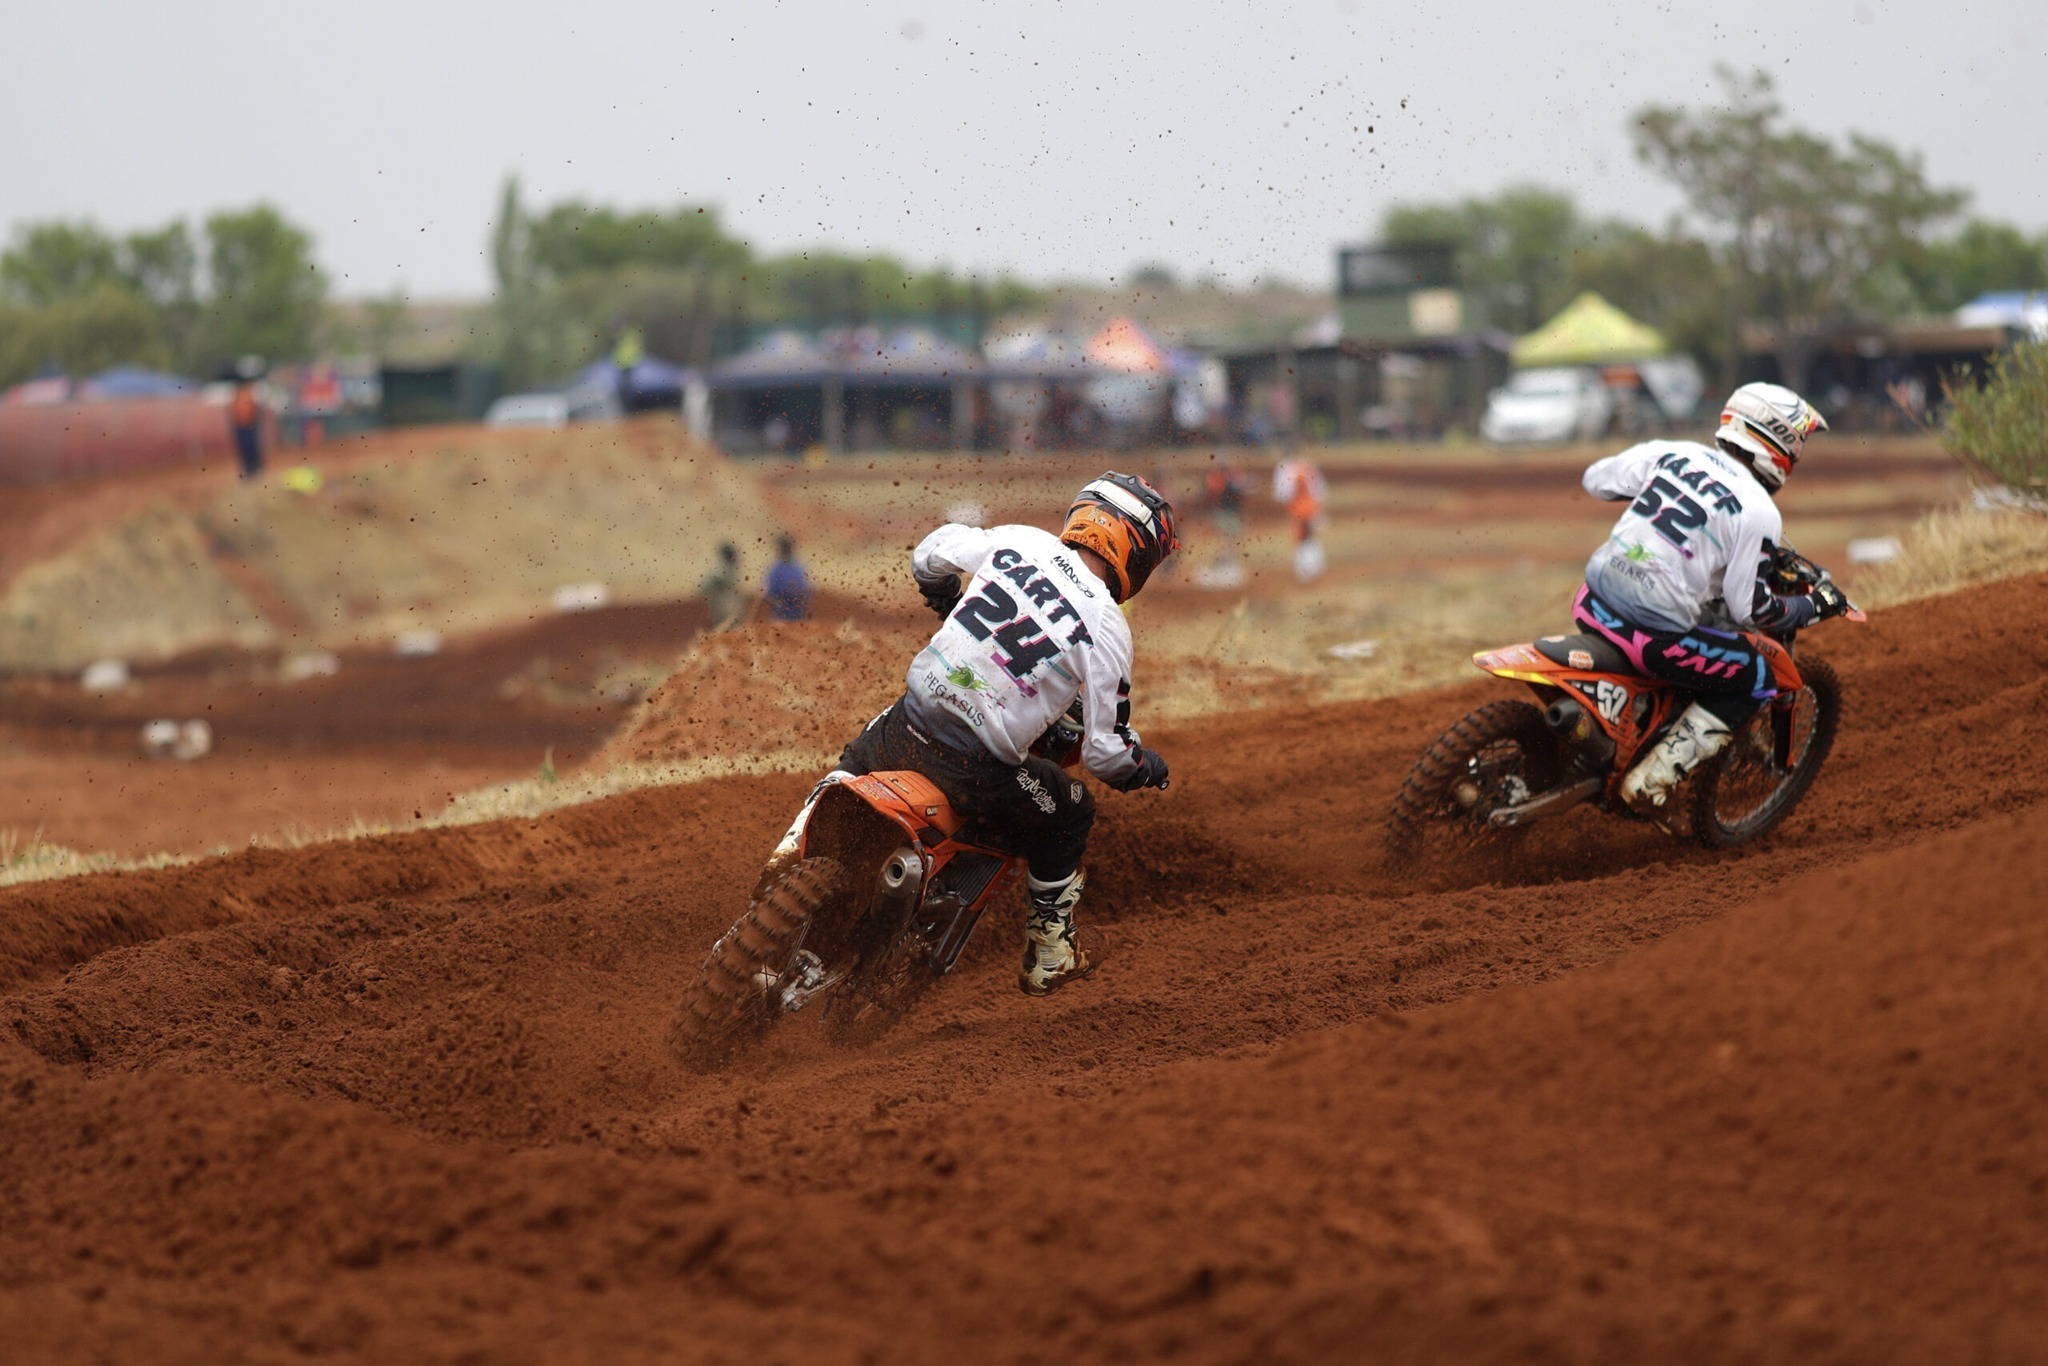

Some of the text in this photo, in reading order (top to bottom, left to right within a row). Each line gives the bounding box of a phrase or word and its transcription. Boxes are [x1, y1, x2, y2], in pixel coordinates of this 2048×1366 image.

[1765, 416, 1797, 444] 100
[1631, 475, 1708, 547] 52
[953, 580, 1063, 679] 24
[991, 548, 1095, 649] CARTY
[923, 671, 986, 728] PEGASUS
[1596, 678, 1628, 726] 52
